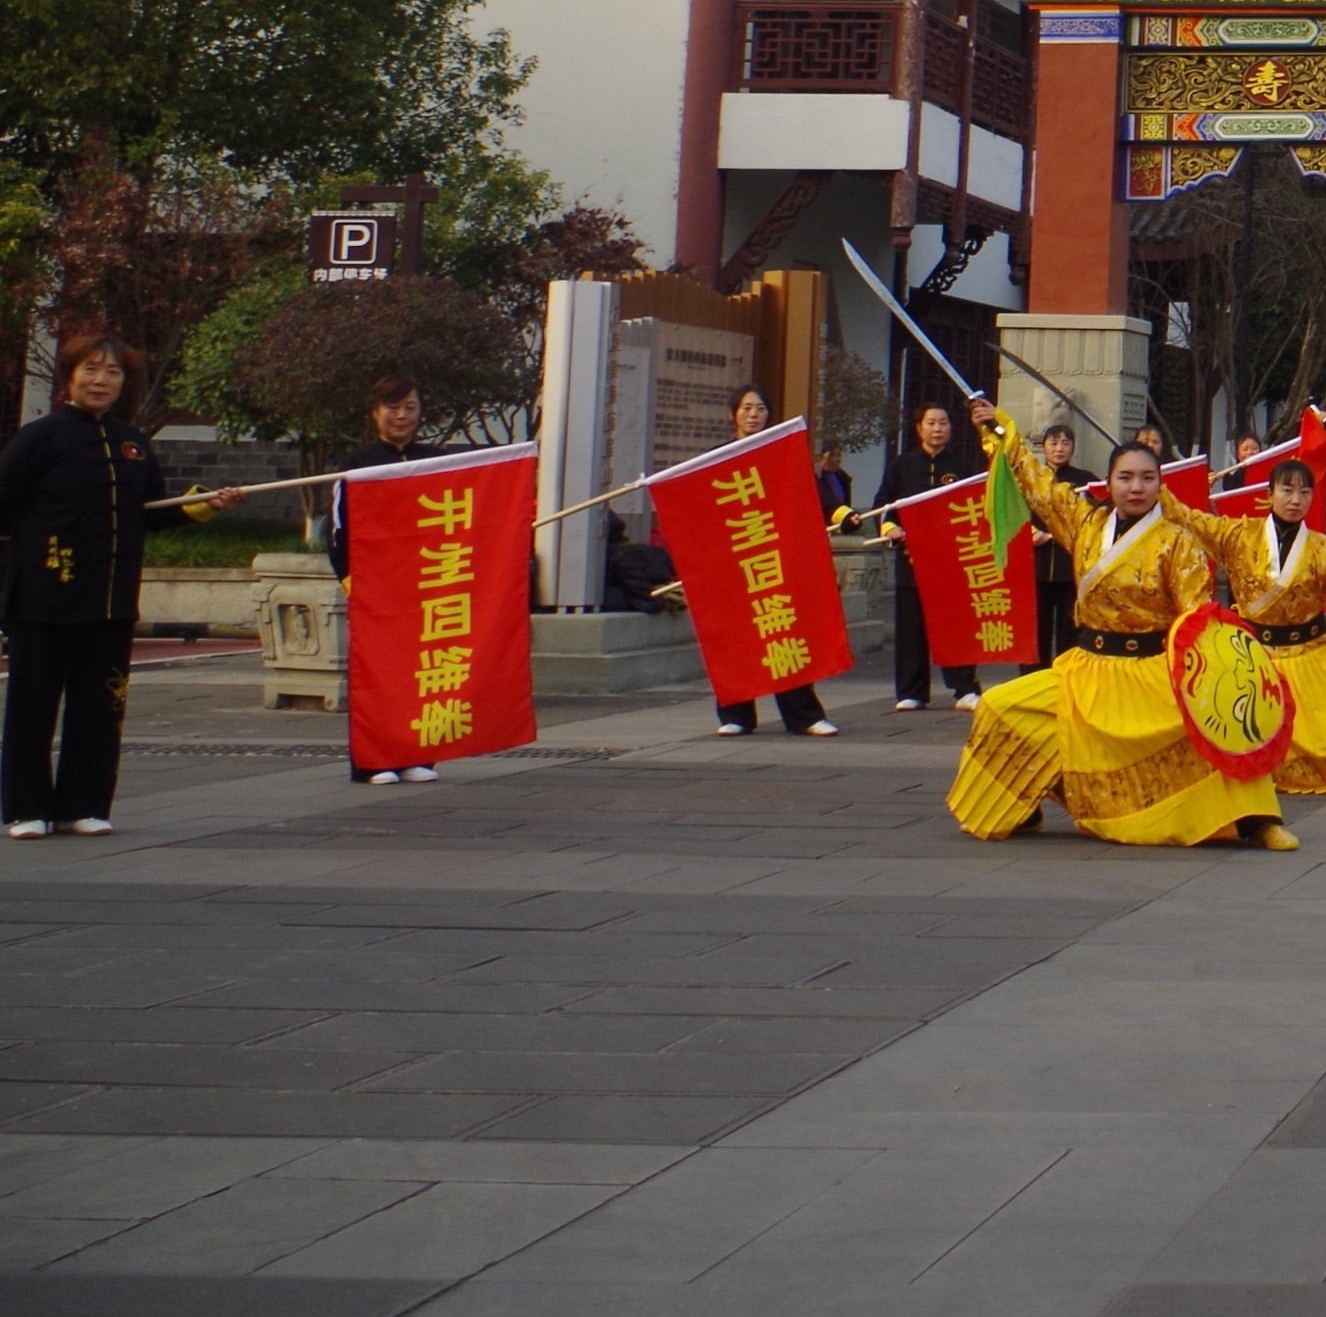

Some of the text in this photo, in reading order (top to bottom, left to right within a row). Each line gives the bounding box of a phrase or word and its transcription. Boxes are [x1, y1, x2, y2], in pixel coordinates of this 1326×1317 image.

[341, 224, 371, 259] P
[410, 487, 476, 748] 开州四维拳
[711, 466, 812, 681] 开州四维拳
